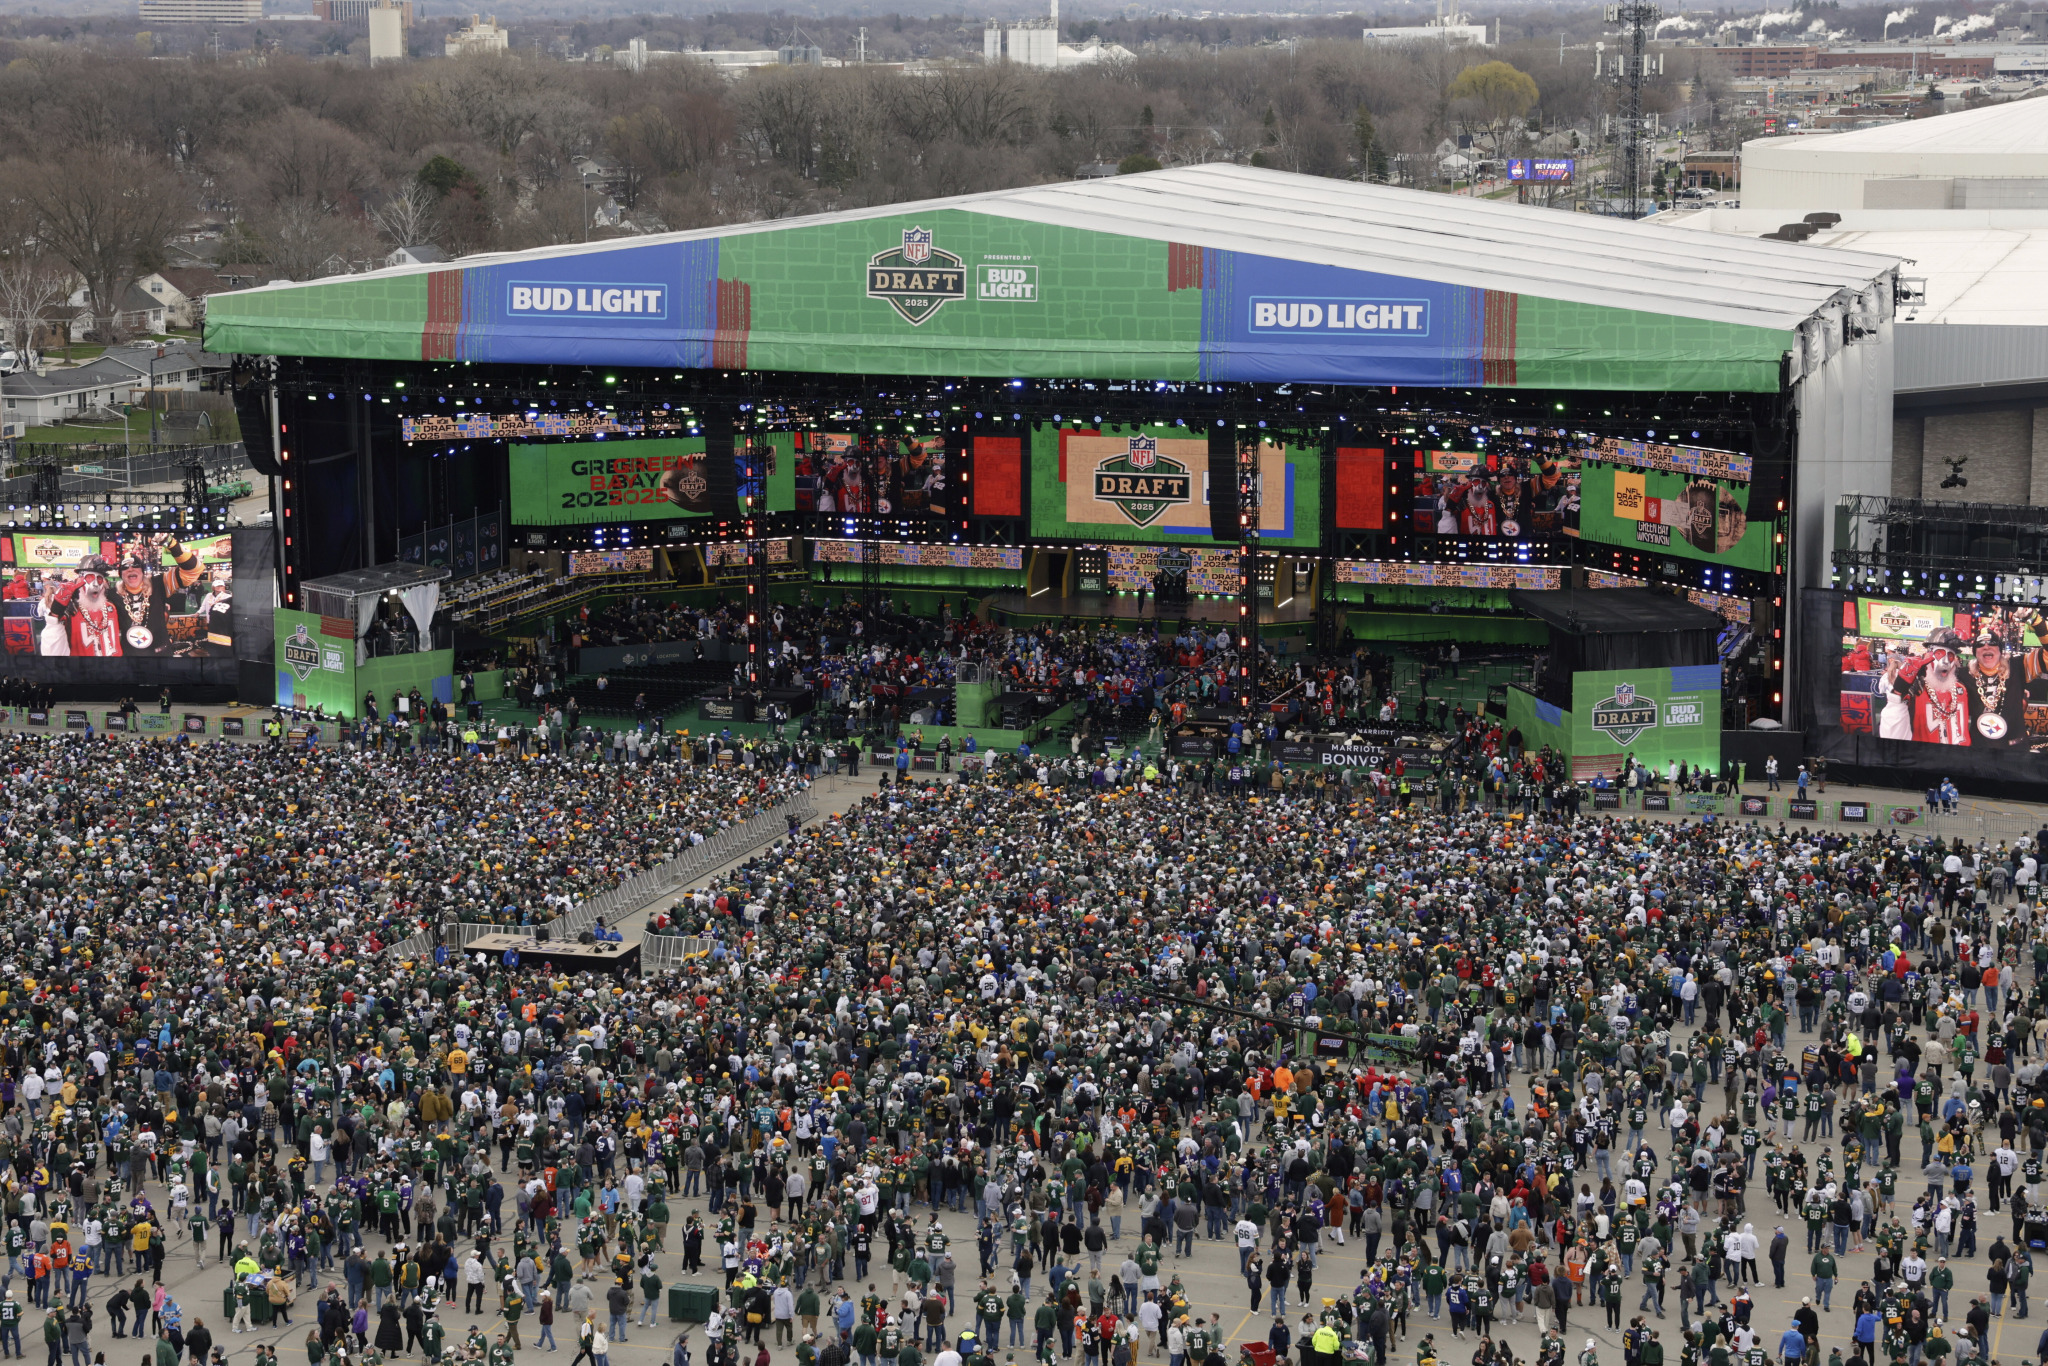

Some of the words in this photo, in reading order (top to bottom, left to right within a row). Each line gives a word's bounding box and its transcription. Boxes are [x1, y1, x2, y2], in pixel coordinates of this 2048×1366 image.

[906, 244, 927, 259] NFL
[875, 272, 958, 290] DRAFT
[988, 269, 1026, 283] BUD
[980, 284, 1033, 298] LIGHT
[513, 287, 573, 311] BUD
[577, 288, 661, 312] LIGHT
[1255, 303, 1323, 327] BUD
[1328, 304, 1423, 330] LIGHT
[569, 426, 594, 434] 2025
[1631, 442, 1645, 450] THE
[1647, 445, 1661, 453] NFL
[1703, 452, 1717, 461] NFL
[1132, 450, 1152, 464] NFL
[1648, 452, 1672, 462] DRAFT
[1703, 460, 1728, 469] DRAFT
[1600, 453, 1618, 462] 2025
[1654, 461, 1672, 470] 2025
[1708, 469, 1728, 477] 2025
[1102, 478, 1184, 495] DRAFT
[609, 488, 669, 506] 2025
[1626, 488, 1641, 496] NFL
[1616, 493, 1643, 502] DRAFT
[1131, 503, 1154, 511] 2025
[288, 648, 317, 663] DRAFT
[326, 652, 340, 662] BUD
[324, 661, 343, 670] LIGHT
[1618, 694, 1632, 704] NFL
[1671, 705, 1695, 714] BUD
[1598, 711, 1651, 724] DRAFT
[1666, 713, 1700, 724] LIGHT
[1332, 744, 1382, 753] MARRIOTT
[1895, 1027, 1904, 1036] 17
[1384, 1039, 1417, 1048] GREEN
[1992, 1039, 2002, 1048] 33
[1963, 1055, 1974, 1064] 80
[1325, 1089, 1334, 1098] 10
[1920, 1086, 1932, 1096] 92
[1784, 1101, 1793, 1110] 10
[1808, 1101, 1819, 1112] 10
[887, 1118, 897, 1127] 17
[1743, 1135, 1755, 1146] 50
[85, 1150, 95, 1160] 10
[1999, 1155, 2009, 1165] 12
[815, 1161, 826, 1171] 60
[1641, 1166, 1651, 1176] 17
[1780, 1170, 1786, 1180] 8
[1884, 1176, 1891, 1186] 8
[110, 1182, 121, 1193] 23
[1628, 1185, 1637, 1195] 10
[58, 1204, 67, 1213] 17
[1809, 1210, 1822, 1220] 88
[86, 1226, 92, 1234] 8
[108, 1227, 119, 1236] 45
[139, 1230, 148, 1239] 10
[1622, 1232, 1635, 1242] 23
[12, 1238, 23, 1248] 66
[56, 1248, 67, 1258] 29
[74, 1262, 85, 1272] 30
[1908, 1265, 1918, 1275] 10
[1609, 1284, 1619, 1294] 10
[1450, 1293, 1460, 1304] 51
[1478, 1296, 1488, 1306] 12
[985, 1302, 997, 1313] 33
[1885, 1307, 1898, 1318] 26
[2, 1308, 14, 1319] 21
